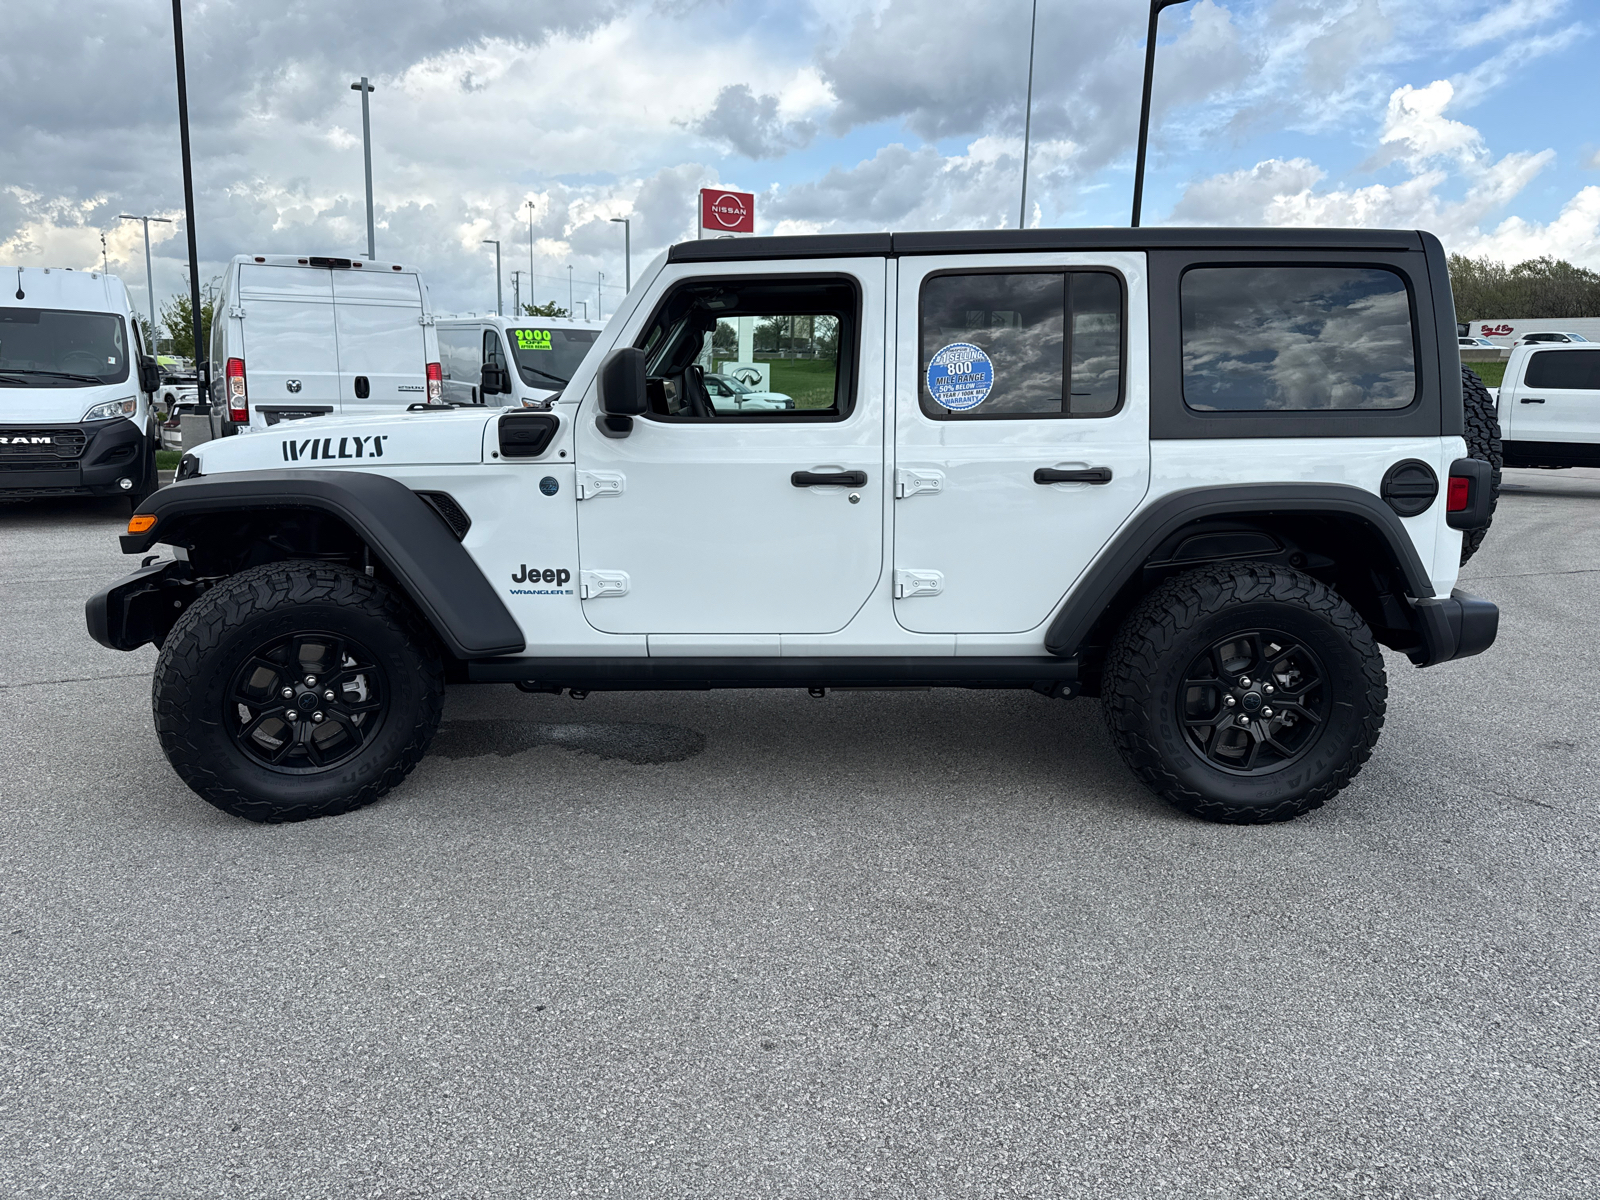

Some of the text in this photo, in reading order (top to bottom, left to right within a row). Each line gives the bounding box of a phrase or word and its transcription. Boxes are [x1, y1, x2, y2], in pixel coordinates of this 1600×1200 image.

[711, 205, 747, 215] NISSAN
[514, 329, 552, 341] 9000
[935, 354, 947, 363] #1
[949, 351, 983, 362] SELLING
[947, 361, 973, 376] 800
[936, 373, 985, 386] MILE RANGE
[939, 384, 955, 393] 50%
[955, 383, 976, 391] BELOW
[944, 396, 979, 404] WARRANTY
[282, 435, 388, 462] WILLYS
[511, 563, 570, 587] Jeep
